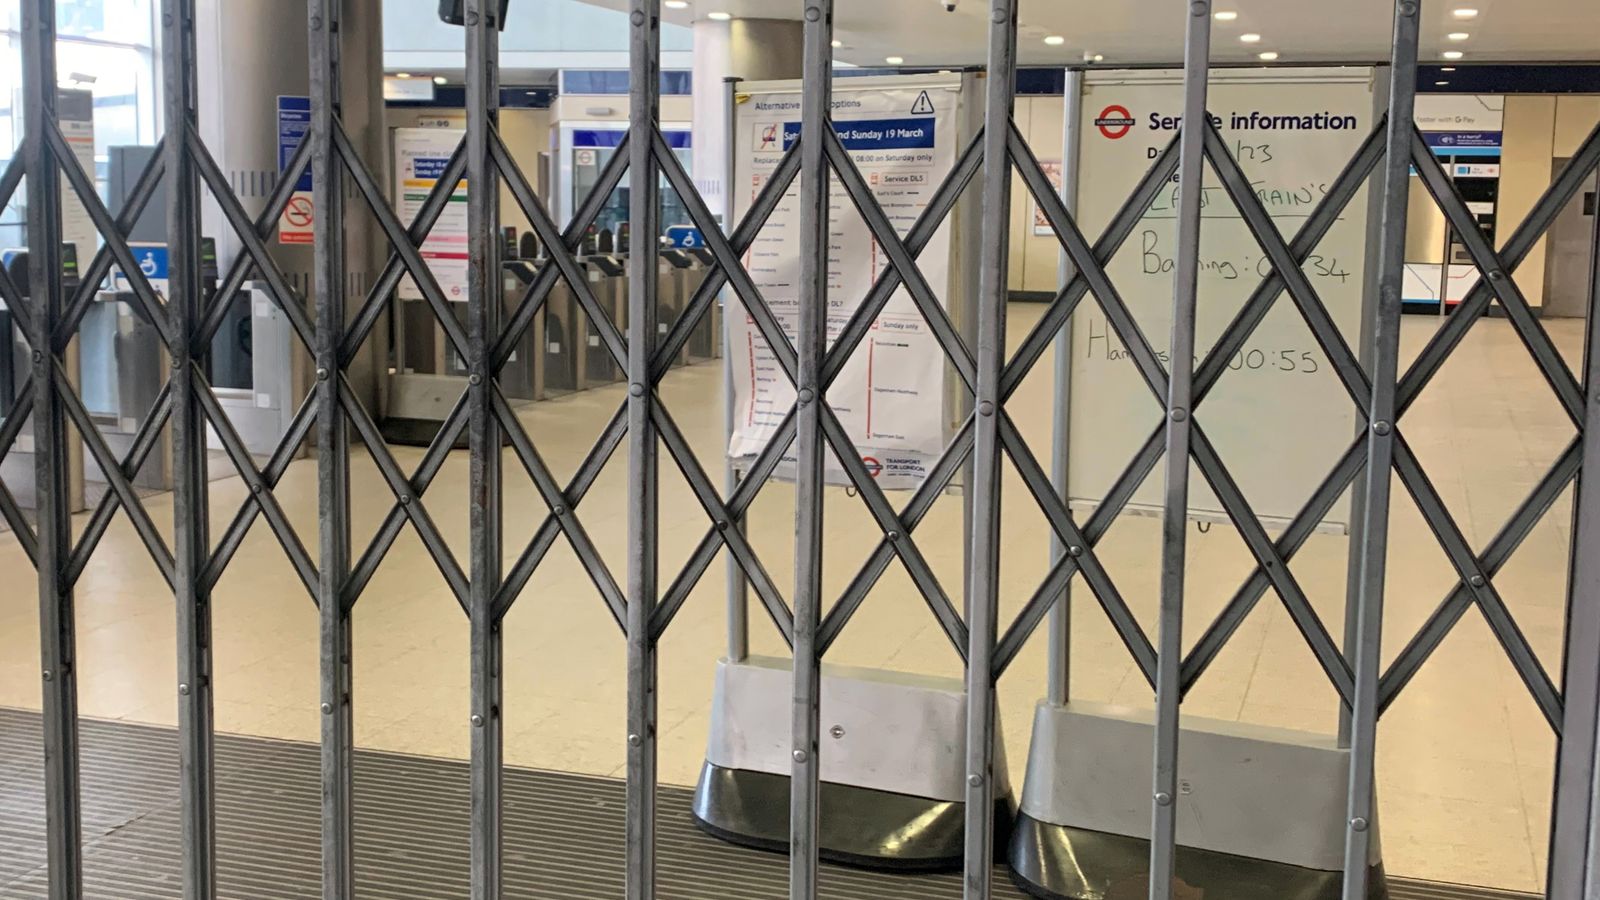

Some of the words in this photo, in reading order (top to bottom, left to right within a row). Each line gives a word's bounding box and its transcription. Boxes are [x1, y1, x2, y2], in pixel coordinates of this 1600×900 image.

[755, 101, 801, 111] Alternative
[831, 99, 861, 109] options
[1149, 112, 1223, 130] Sere
[1230, 111, 1357, 130] information
[851, 130, 882, 140] Sunday
[885, 129, 895, 138] 19
[897, 128, 924, 138] March
[885, 154, 914, 163] Saturday
[917, 153, 933, 162] only
[884, 175, 909, 183] Service
[1151, 185, 1222, 211] LAT
[1142, 230, 1249, 280] Baing:
[883, 321, 904, 330] Sunday
[905, 323, 919, 331] only
[886, 457, 921, 465] TRANSPORT
[899, 464, 925, 473] LONDON
